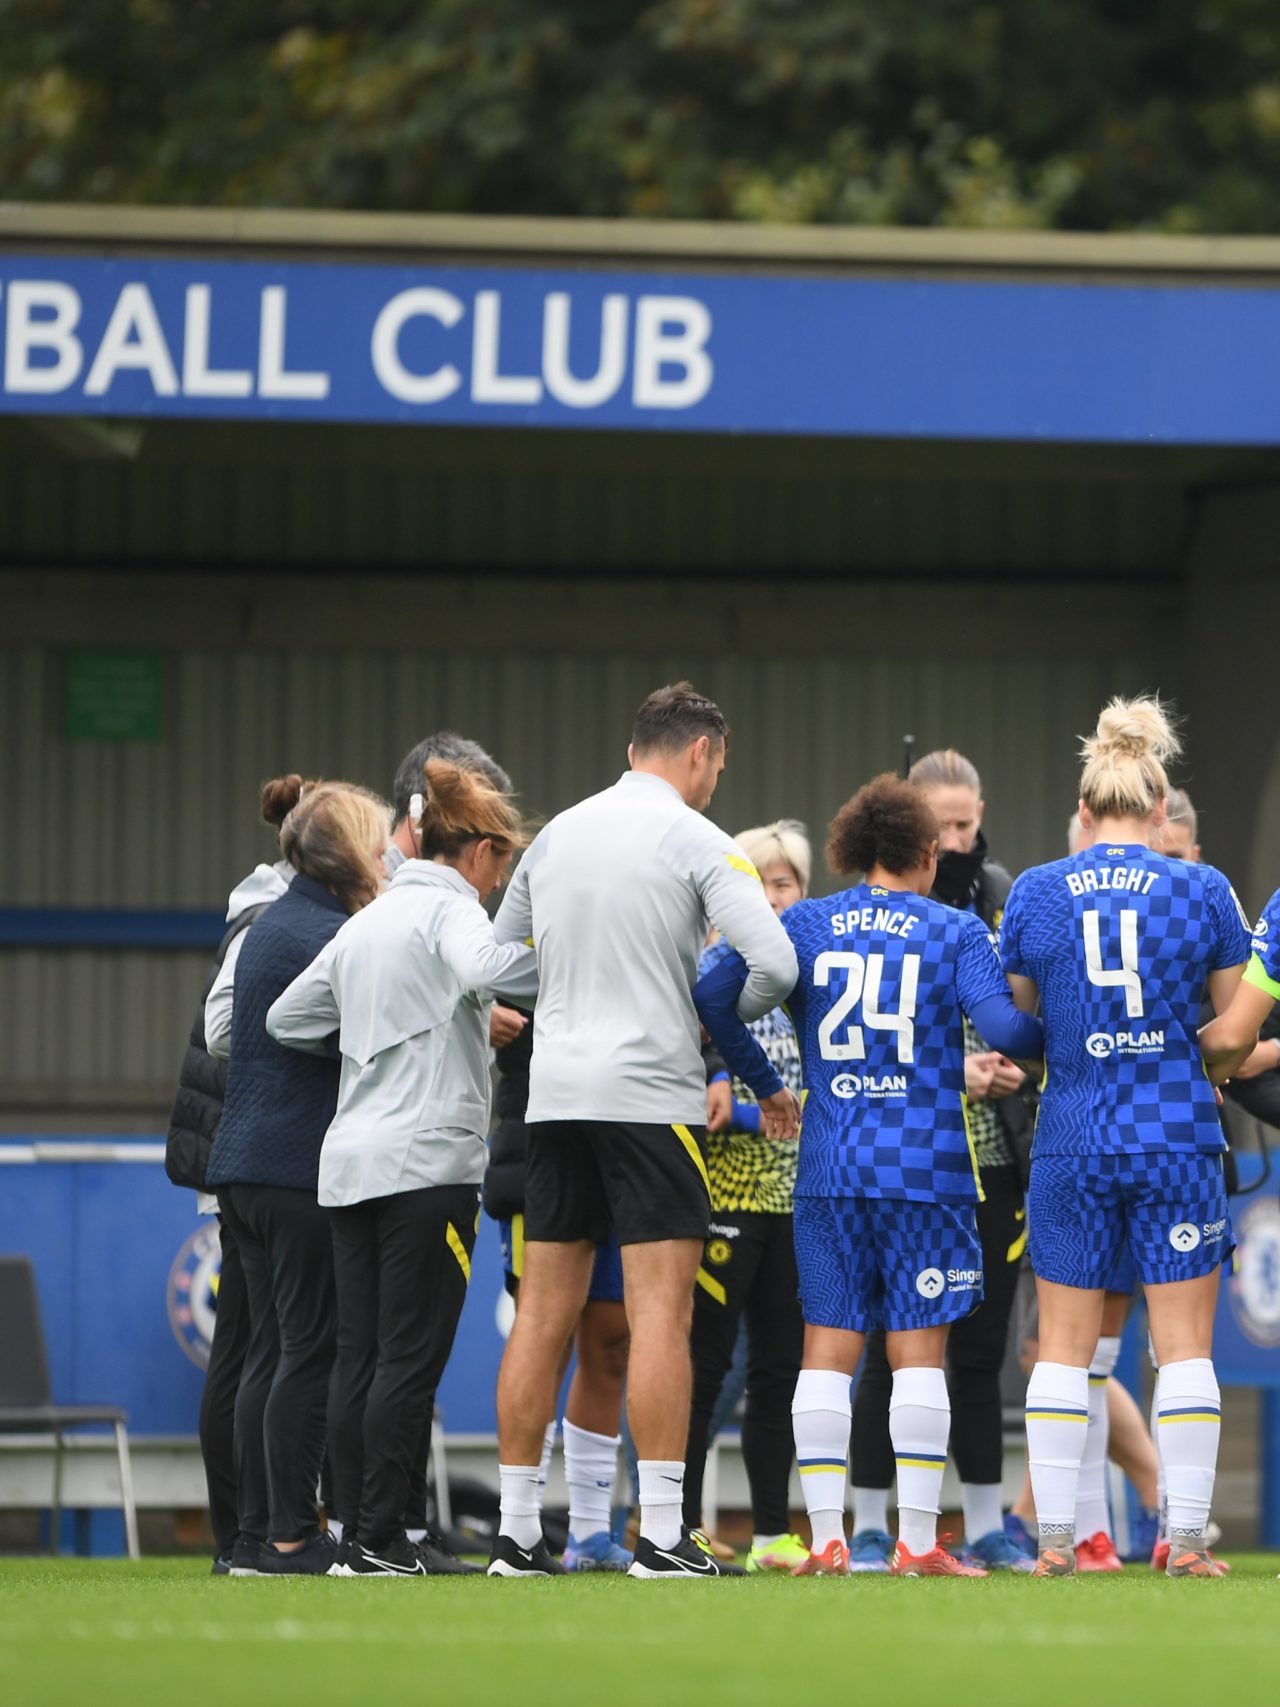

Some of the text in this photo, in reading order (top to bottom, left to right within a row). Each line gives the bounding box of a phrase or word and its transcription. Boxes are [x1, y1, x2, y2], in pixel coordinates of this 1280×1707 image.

[0, 279, 714, 409] BALL CLUB
[1106, 848, 1126, 856] CFC
[870, 888, 889, 896] CFC
[1065, 867, 1159, 896] BRIGHT
[831, 907, 920, 938] SPENCE
[1083, 910, 1145, 1018] 4
[813, 951, 921, 1064] 24
[1116, 1030, 1164, 1047] PLAN
[1117, 1046, 1165, 1054] INTERNATIONAL
[863, 1075, 907, 1091] PLAN
